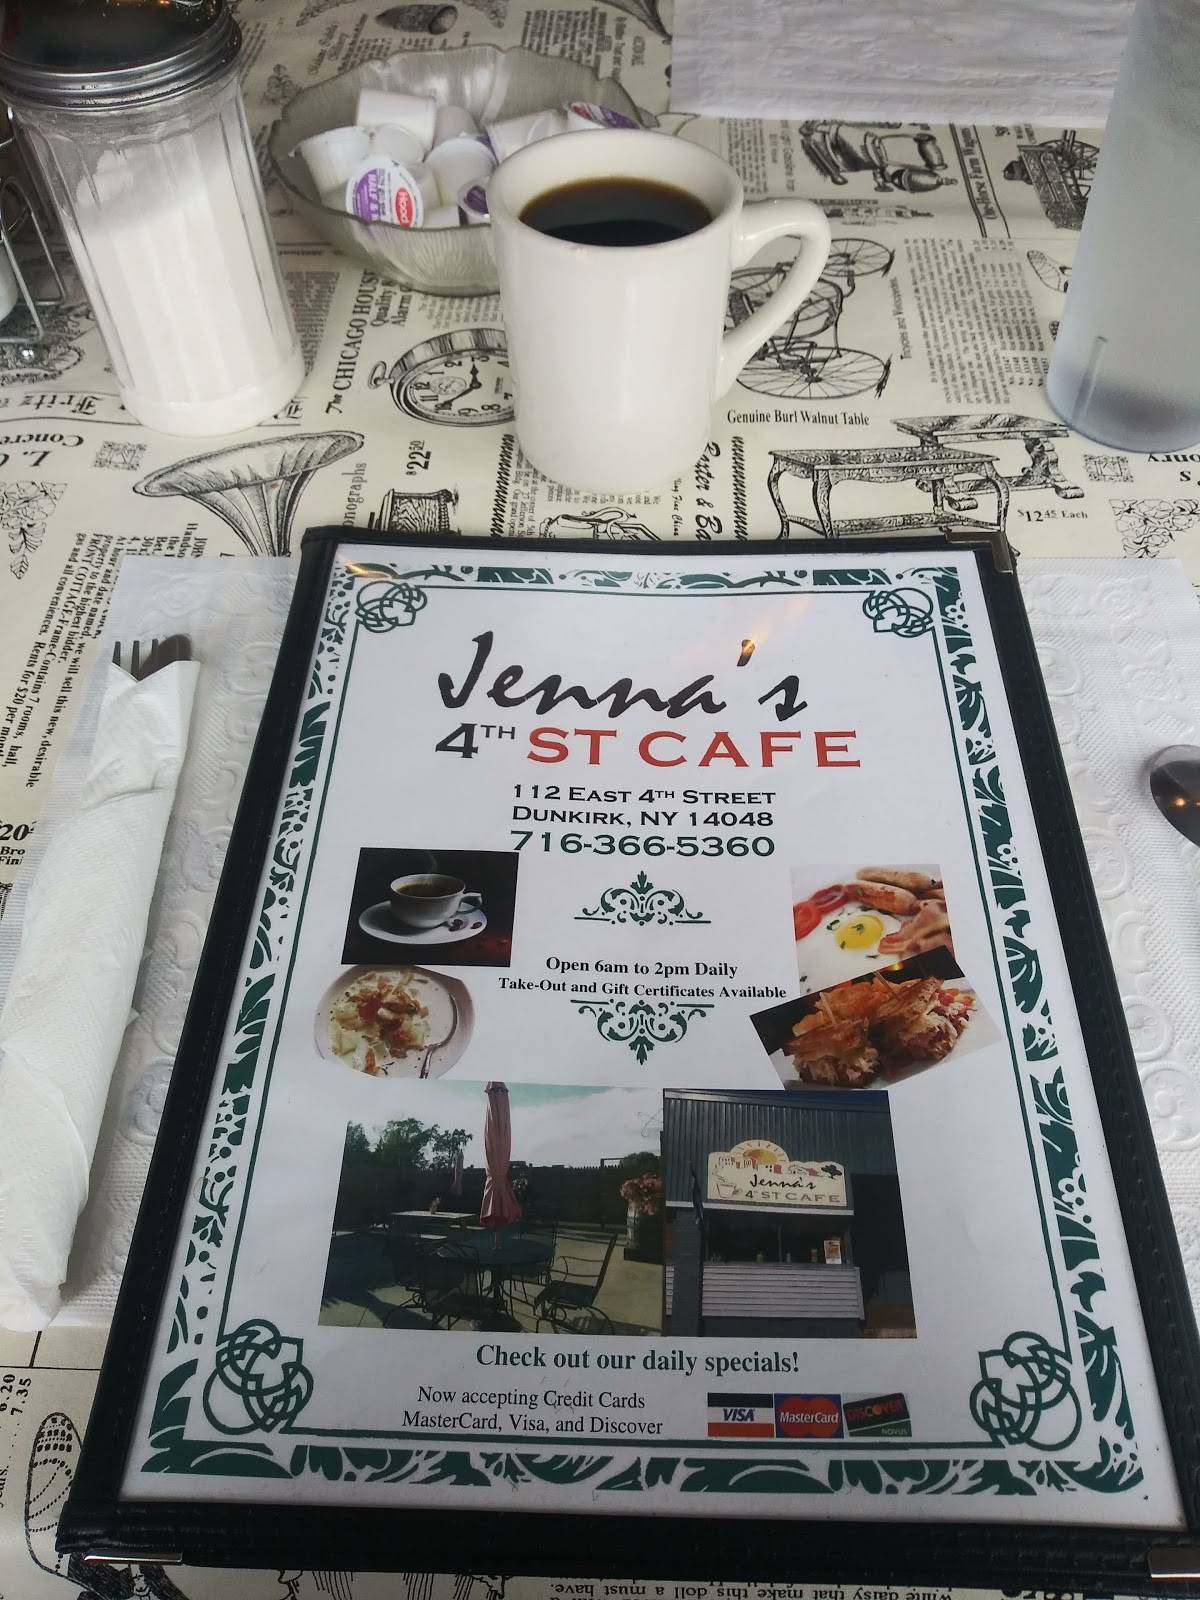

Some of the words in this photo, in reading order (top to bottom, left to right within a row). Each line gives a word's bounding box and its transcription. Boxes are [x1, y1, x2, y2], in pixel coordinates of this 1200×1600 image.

[368, 173, 378, 201] HALF
[398, 191, 409, 223] Hood
[370, 289, 397, 327] Quality
[391, 295, 412, 327] Alarm
[333, 318, 367, 391] CHICAGO
[414, 382, 430, 390] 12
[18, 394, 103, 416] Fritz
[325, 394, 343, 414] The
[727, 409, 771, 424] Genuine
[774, 409, 798, 423] Burl
[800, 410, 838, 425] Walnut
[840, 412, 870, 426] Table
[22, 450, 52, 467] L.
[672, 495, 682, 511] Fine
[696, 498, 714, 508] &
[1062, 510, 1088, 519] Each
[672, 514, 683, 536] China
[116, 536, 127, 545] At
[170, 536, 180, 550] the
[68, 547, 80, 562] and
[91, 533, 113, 569] property
[108, 547, 124, 567] hour
[63, 564, 74, 576] all
[90, 571, 100, 580] to
[101, 568, 113, 584] and
[83, 582, 97, 595] the
[93, 586, 108, 605] date
[71, 597, 93, 629] highest
[80, 607, 98, 639] named,
[26, 641, 47, 668] Rents
[58, 630, 80, 664] bidder.
[75, 642, 86, 655] we
[67, 657, 80, 674] will
[20, 670, 35, 685] for
[60, 677, 73, 693] sell
[438, 631, 808, 722] Jenna's
[12, 686, 29, 705] $20
[53, 695, 69, 713] this
[5, 706, 18, 724] per
[12, 705, 34, 739] rooms,
[42, 715, 59, 739] new,
[435, 723, 516, 759] 4TH
[527, 727, 617, 765] ST
[638, 730, 861, 768] CAFE
[1, 745, 22, 768] hall,
[25, 740, 52, 788] desirable
[513, 784, 561, 800] 112
[640, 811, 679, 827] NY
[689, 811, 774, 827] 14048
[510, 830, 776, 857] 716-366-5360
[545, 955, 589, 977] Open
[594, 958, 630, 974] 6am
[634, 961, 650, 974] to
[654, 961, 691, 980] 2pm
[695, 961, 738, 980] Daily
[499, 977, 567, 993] Take-Out
[571, 980, 597, 993] and
[601, 982, 630, 997] Gift
[633, 983, 714, 998] Certificates
[718, 985, 787, 999] Available
[750, 1174, 816, 1189] Jenna's
[761, 1191, 779, 1200] ST
[785, 1192, 840, 1203] CAFE
[476, 1344, 548, 1369] Check
[553, 1348, 591, 1369] out
[596, 1353, 638, 1371] our
[643, 1348, 698, 1376] daily
[704, 1349, 801, 1377] specials!
[10, 1377, 32, 1416] 7.35
[417, 1386, 457, 1404] Now
[461, 1387, 539, 1411] accepting
[543, 1389, 595, 1409] Credit
[598, 1391, 646, 1410] Cards
[723, 1408, 755, 1421] VISA
[780, 1411, 839, 1424] MasterCard
[849, 1401, 905, 1421] DISCOVER
[402, 1411, 502, 1433] MasterCard,
[508, 1415, 550, 1434] Visa,
[555, 1417, 585, 1434] and
[590, 1416, 664, 1436] Discover
[881, 1427, 908, 1436] NOVUS
[550, 1583, 594, 1597] have.
[604, 1585, 646, 1596] must
[655, 1586, 665, 1595] a
[674, 1586, 708, 1599] doll
[716, 1586, 748, 1600] this
[757, 1588, 803, 1600] make
[813, 1589, 846, 1600] that
[852, 1589, 899, 1600] daisy
